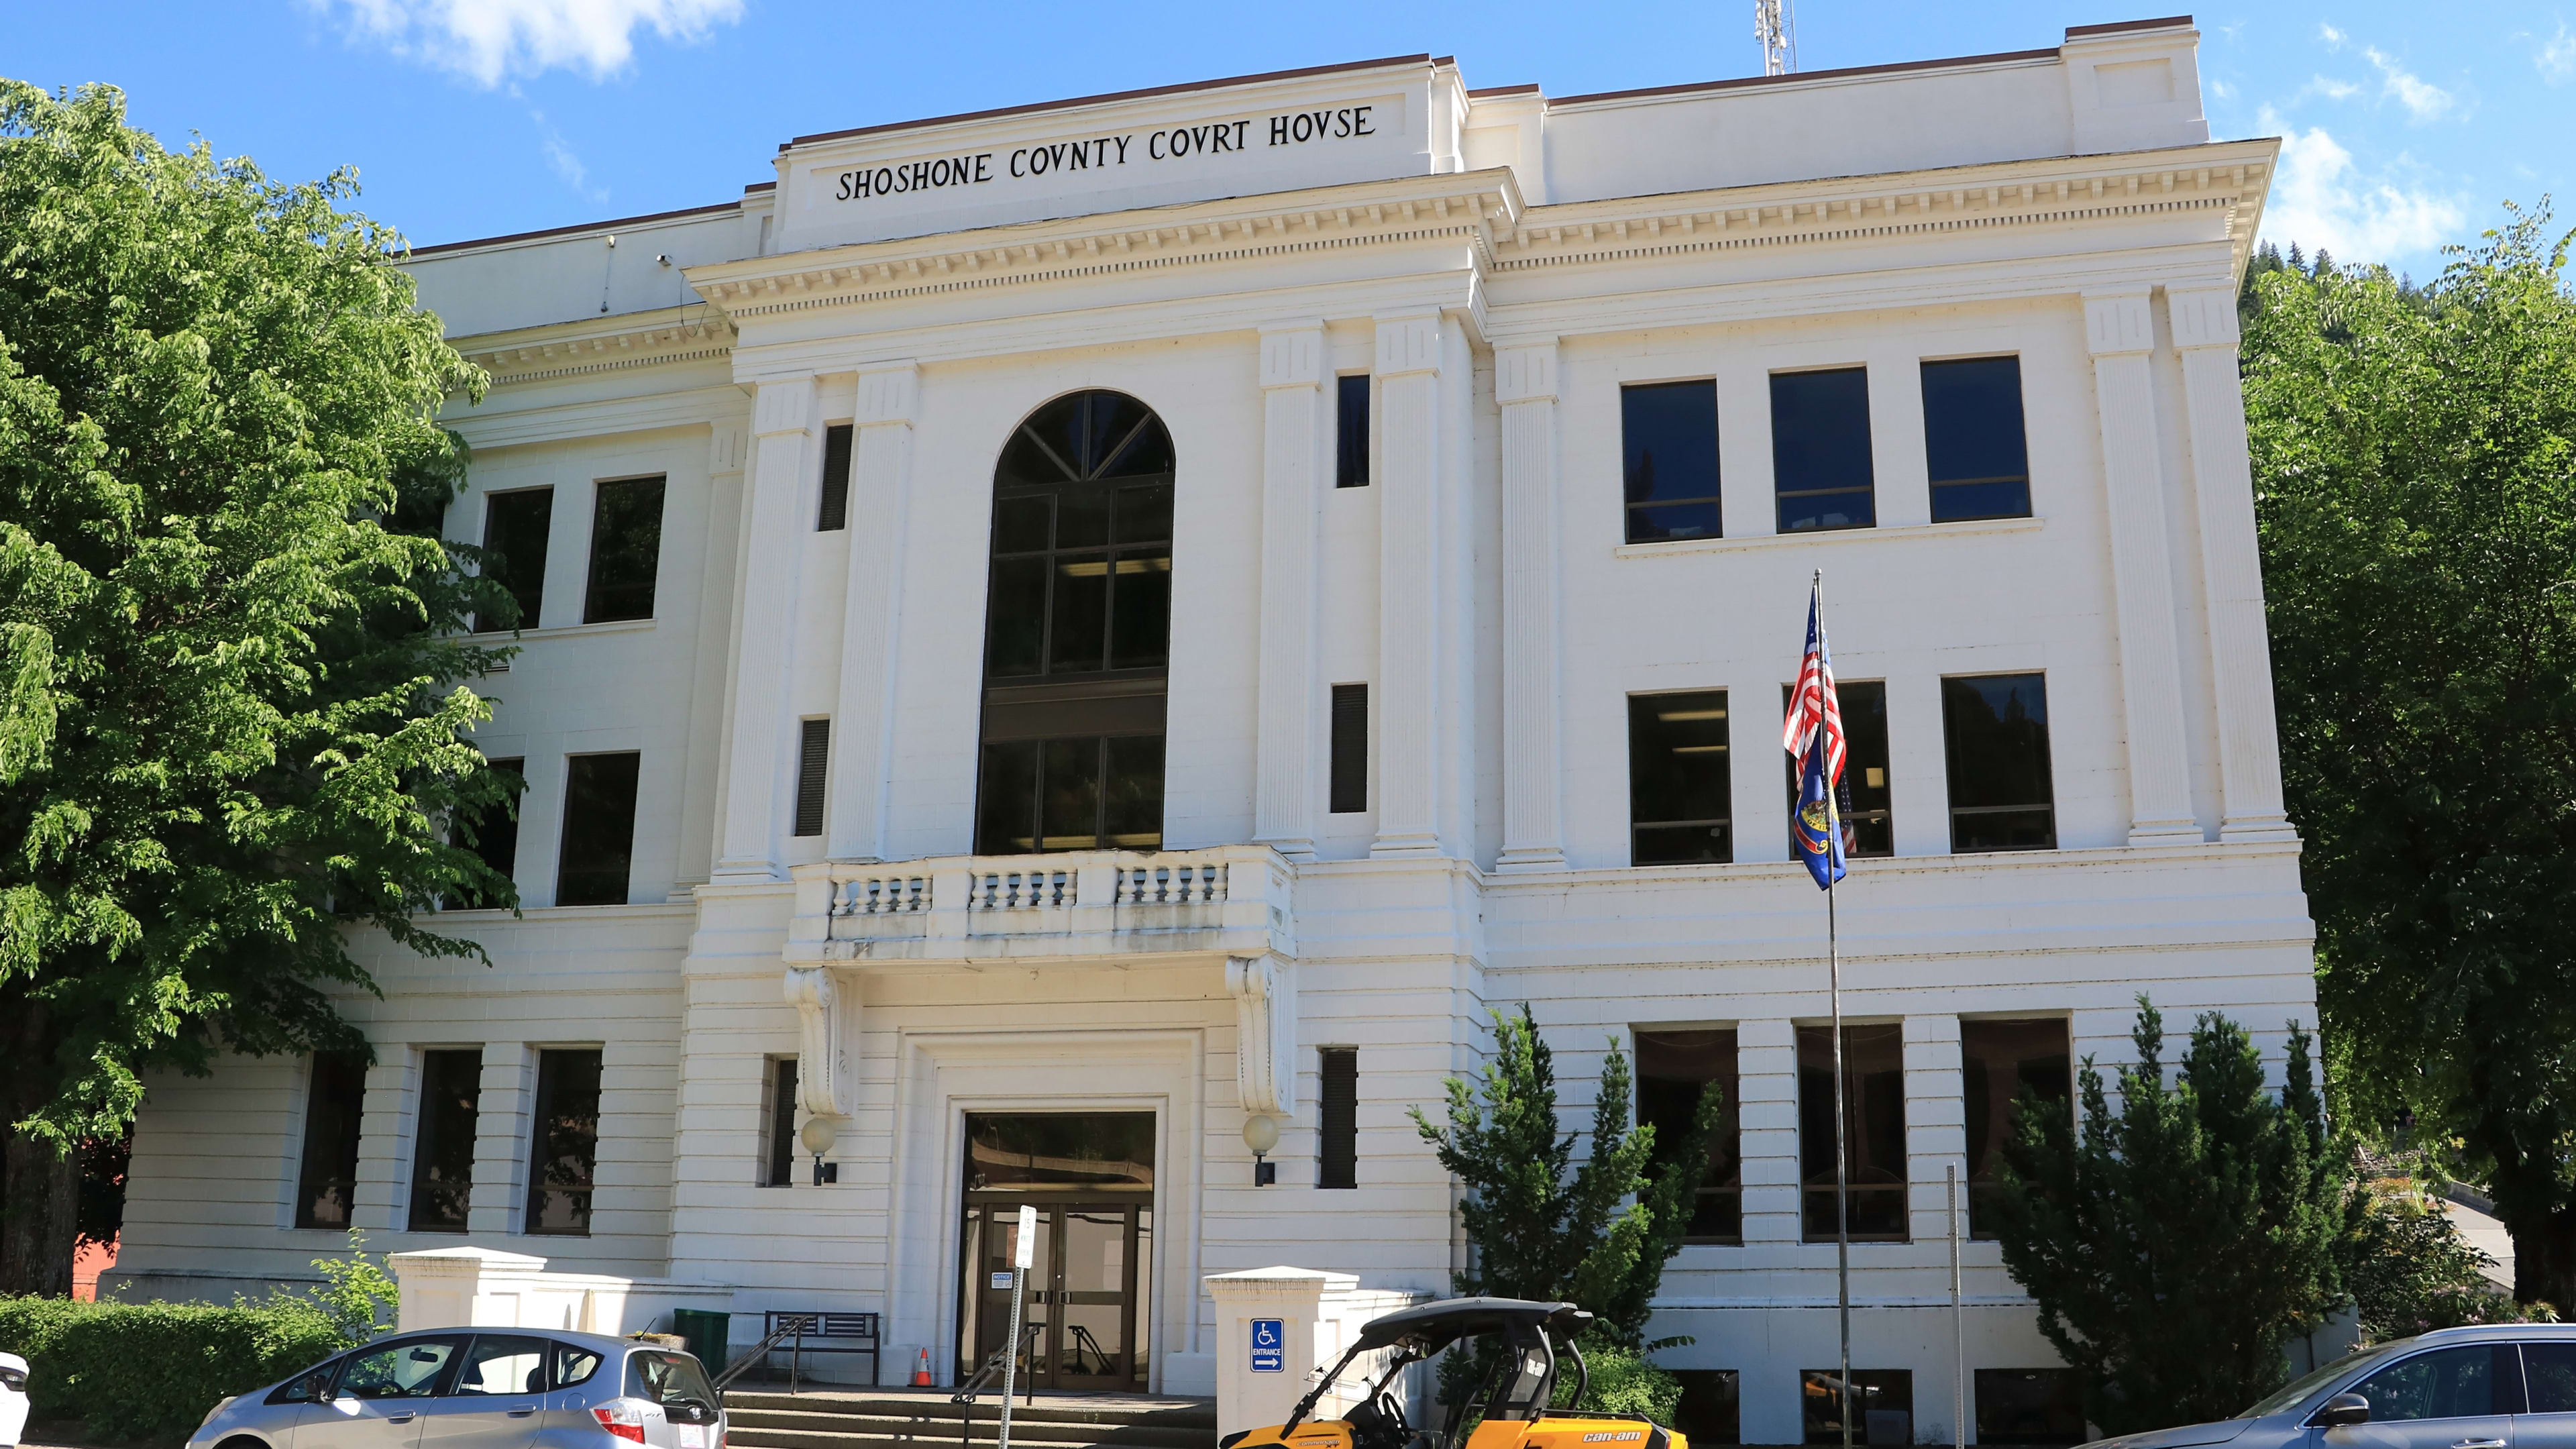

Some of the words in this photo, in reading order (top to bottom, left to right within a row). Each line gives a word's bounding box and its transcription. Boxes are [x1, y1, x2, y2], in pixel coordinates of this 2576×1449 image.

[835, 153, 994, 201] SHOSHONE
[1252, 1348, 1281, 1356] ENTRANCE
[1582, 1432, 1641, 1442] can-am
